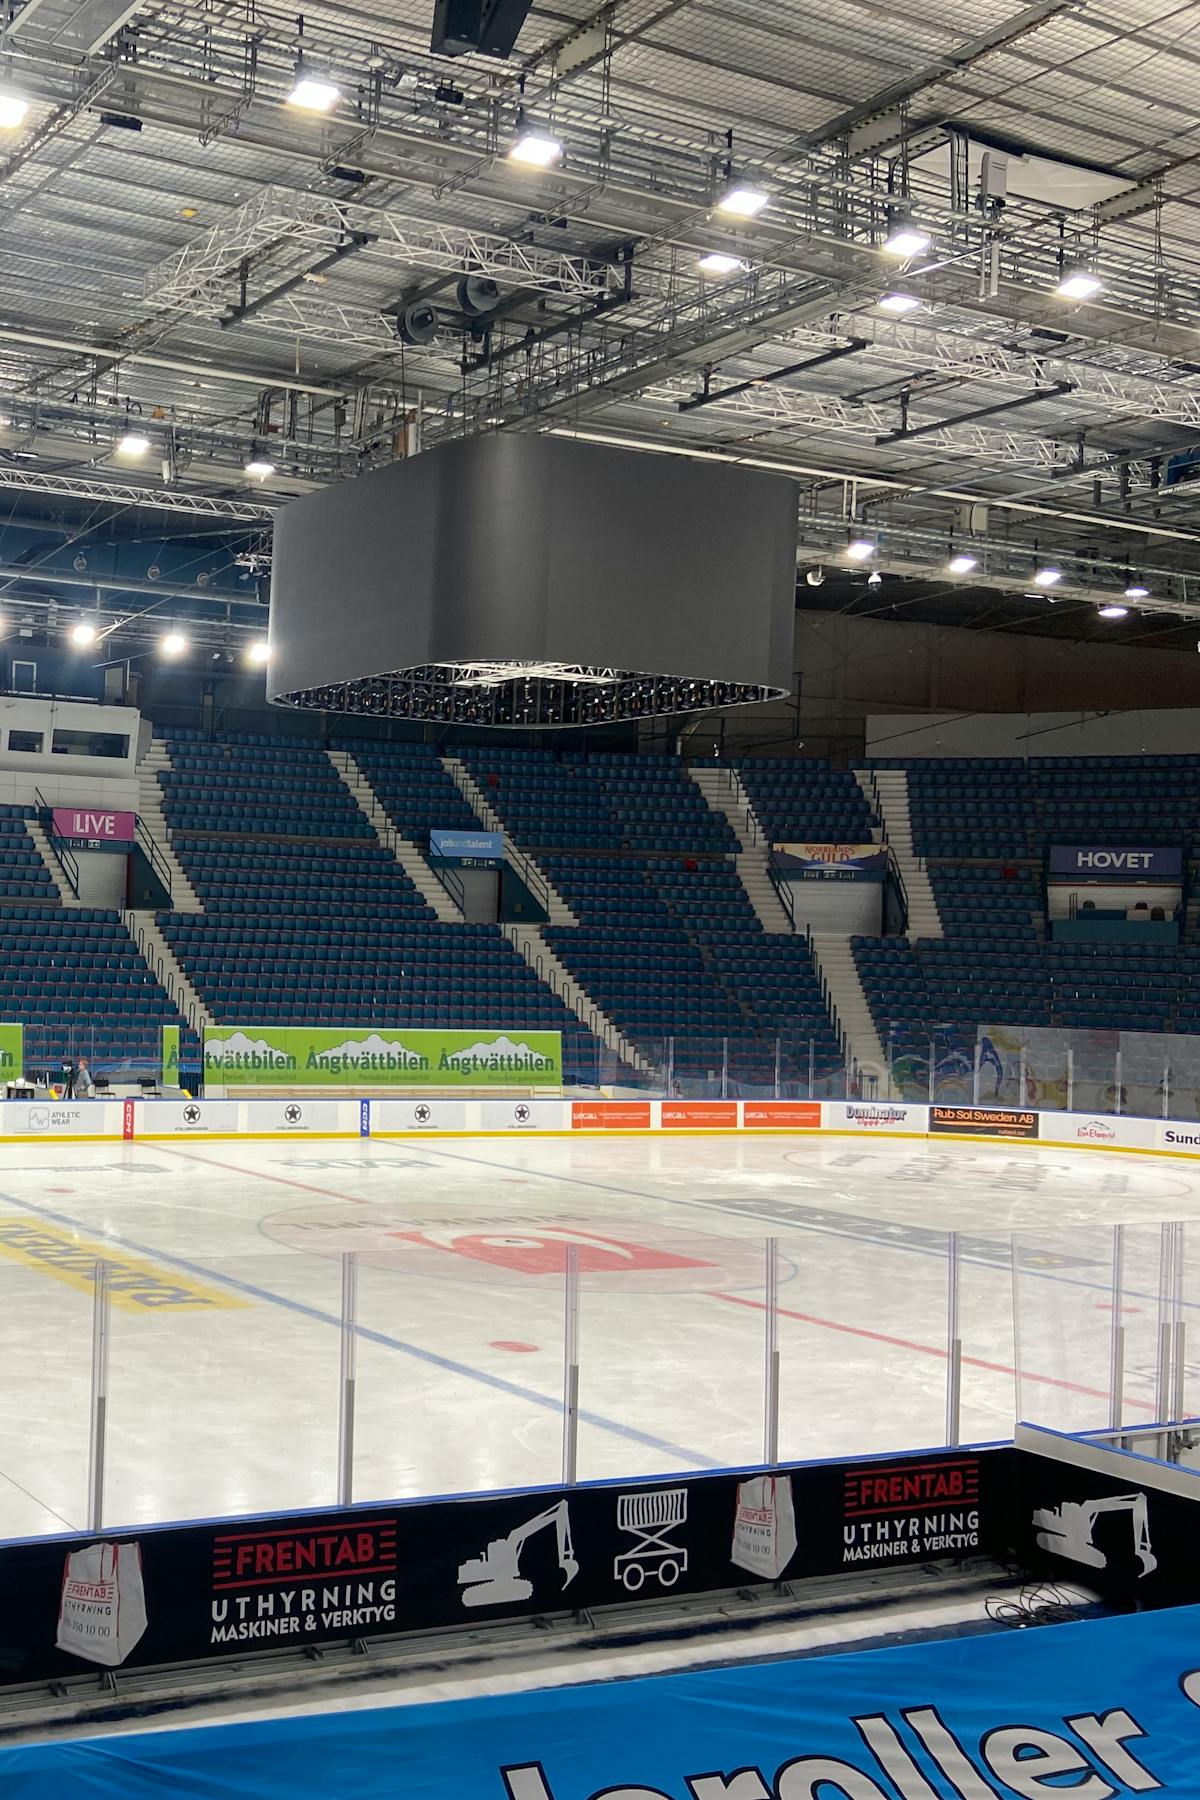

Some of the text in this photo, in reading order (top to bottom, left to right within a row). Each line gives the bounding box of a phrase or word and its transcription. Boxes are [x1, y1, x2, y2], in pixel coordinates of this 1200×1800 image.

[73, 813, 115, 834] LIVE
[804, 845, 857, 855] NORRLANDS
[1077, 851, 1154, 869] HOVET
[205, 1050, 297, 1070] tvättbilen
[306, 1045, 430, 1075] Ångtvättbilen
[438, 1047, 555, 1076] Ångtvättbilen
[51, 1111, 81, 1120] ATHLETIC
[51, 1118, 70, 1126] WEAR
[846, 1105, 907, 1121] Dominator
[933, 1107, 1034, 1124] Rub Sol Sweden AB
[274, 1213, 590, 1232] SVENSKA SPEL
[860, 1471, 964, 1505] FRENTAB
[843, 1510, 980, 1545] UTHYRNING
[236, 1533, 376, 1576] FRENTAB
[842, 1532, 979, 1562] MASKINER & VERKTYG
[71, 1584, 107, 1599] FRENTAB
[211, 1579, 397, 1623] UTHYRNING
[64, 1600, 112, 1616] UTHYRNING
[86, 1625, 96, 1636] 10
[98, 1626, 111, 1637] 00
[210, 1604, 396, 1644] MASKINER & VERKTYG
